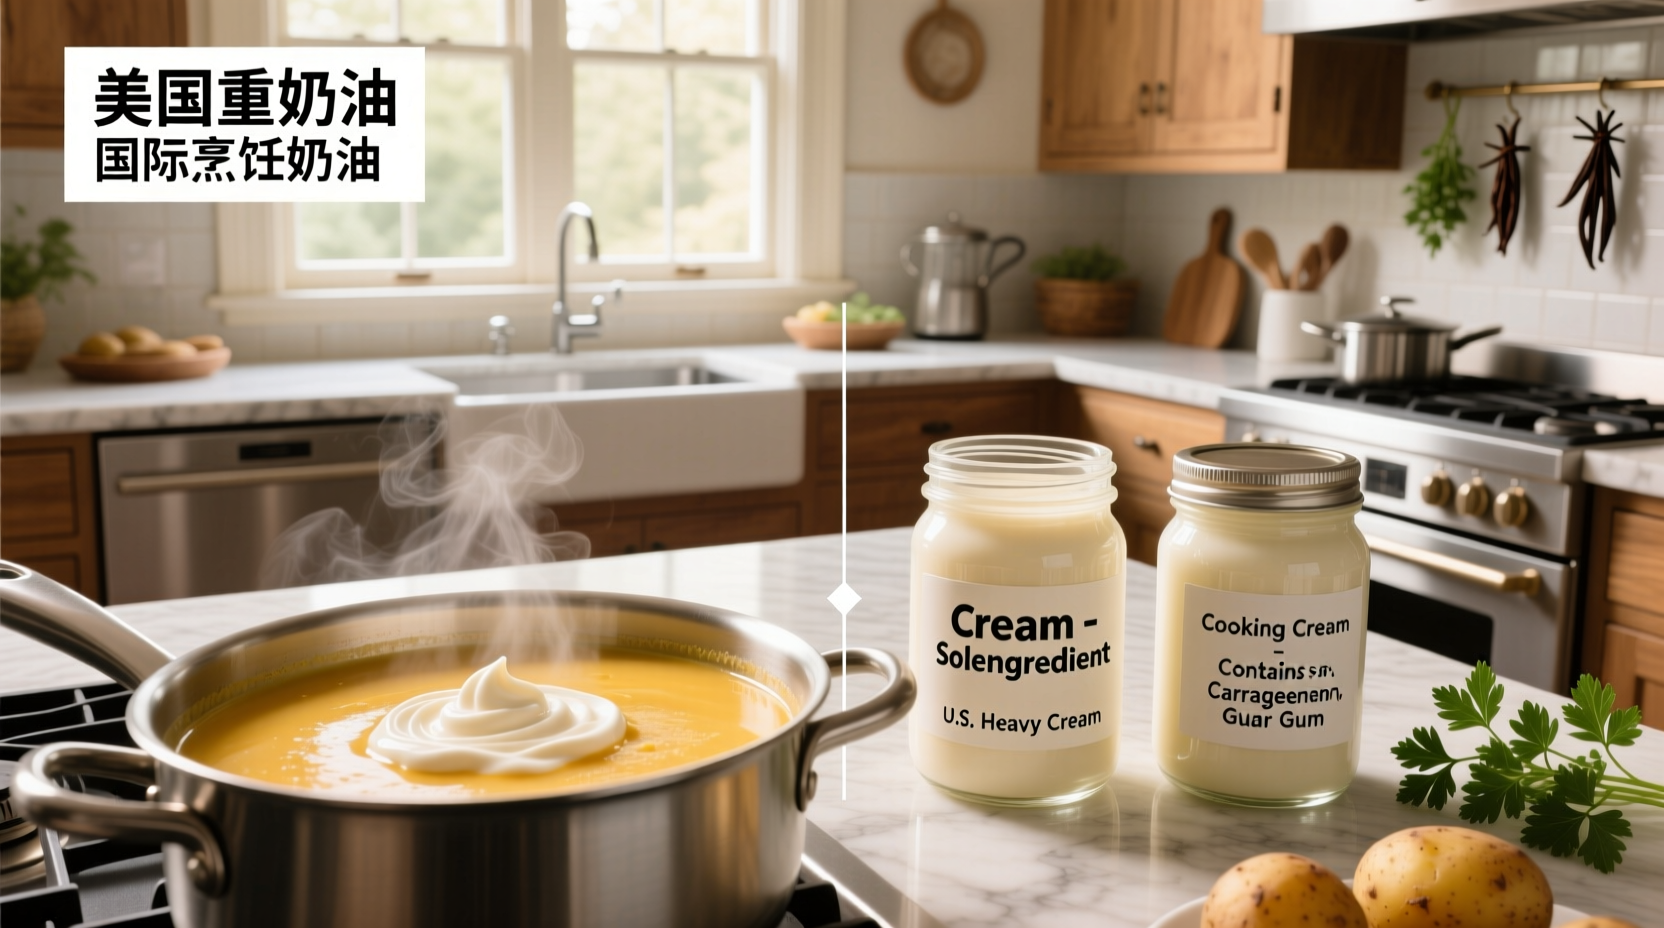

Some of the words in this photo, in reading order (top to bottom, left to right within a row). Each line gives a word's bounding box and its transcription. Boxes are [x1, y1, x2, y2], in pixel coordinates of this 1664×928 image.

[951, 603, 1074, 642] Cream
[1201, 612, 1286, 643] Cooking
[1292, 618, 1350, 638] Cream
[936, 640, 1111, 681] Solengredient
[1218, 657, 1305, 681] Contains
[943, 705, 974, 729] U.S.
[981, 712, 1042, 737] Heavy
[1047, 709, 1102, 731] Cream
[1222, 707, 1273, 728] Guar
[1279, 710, 1325, 728] Gum
